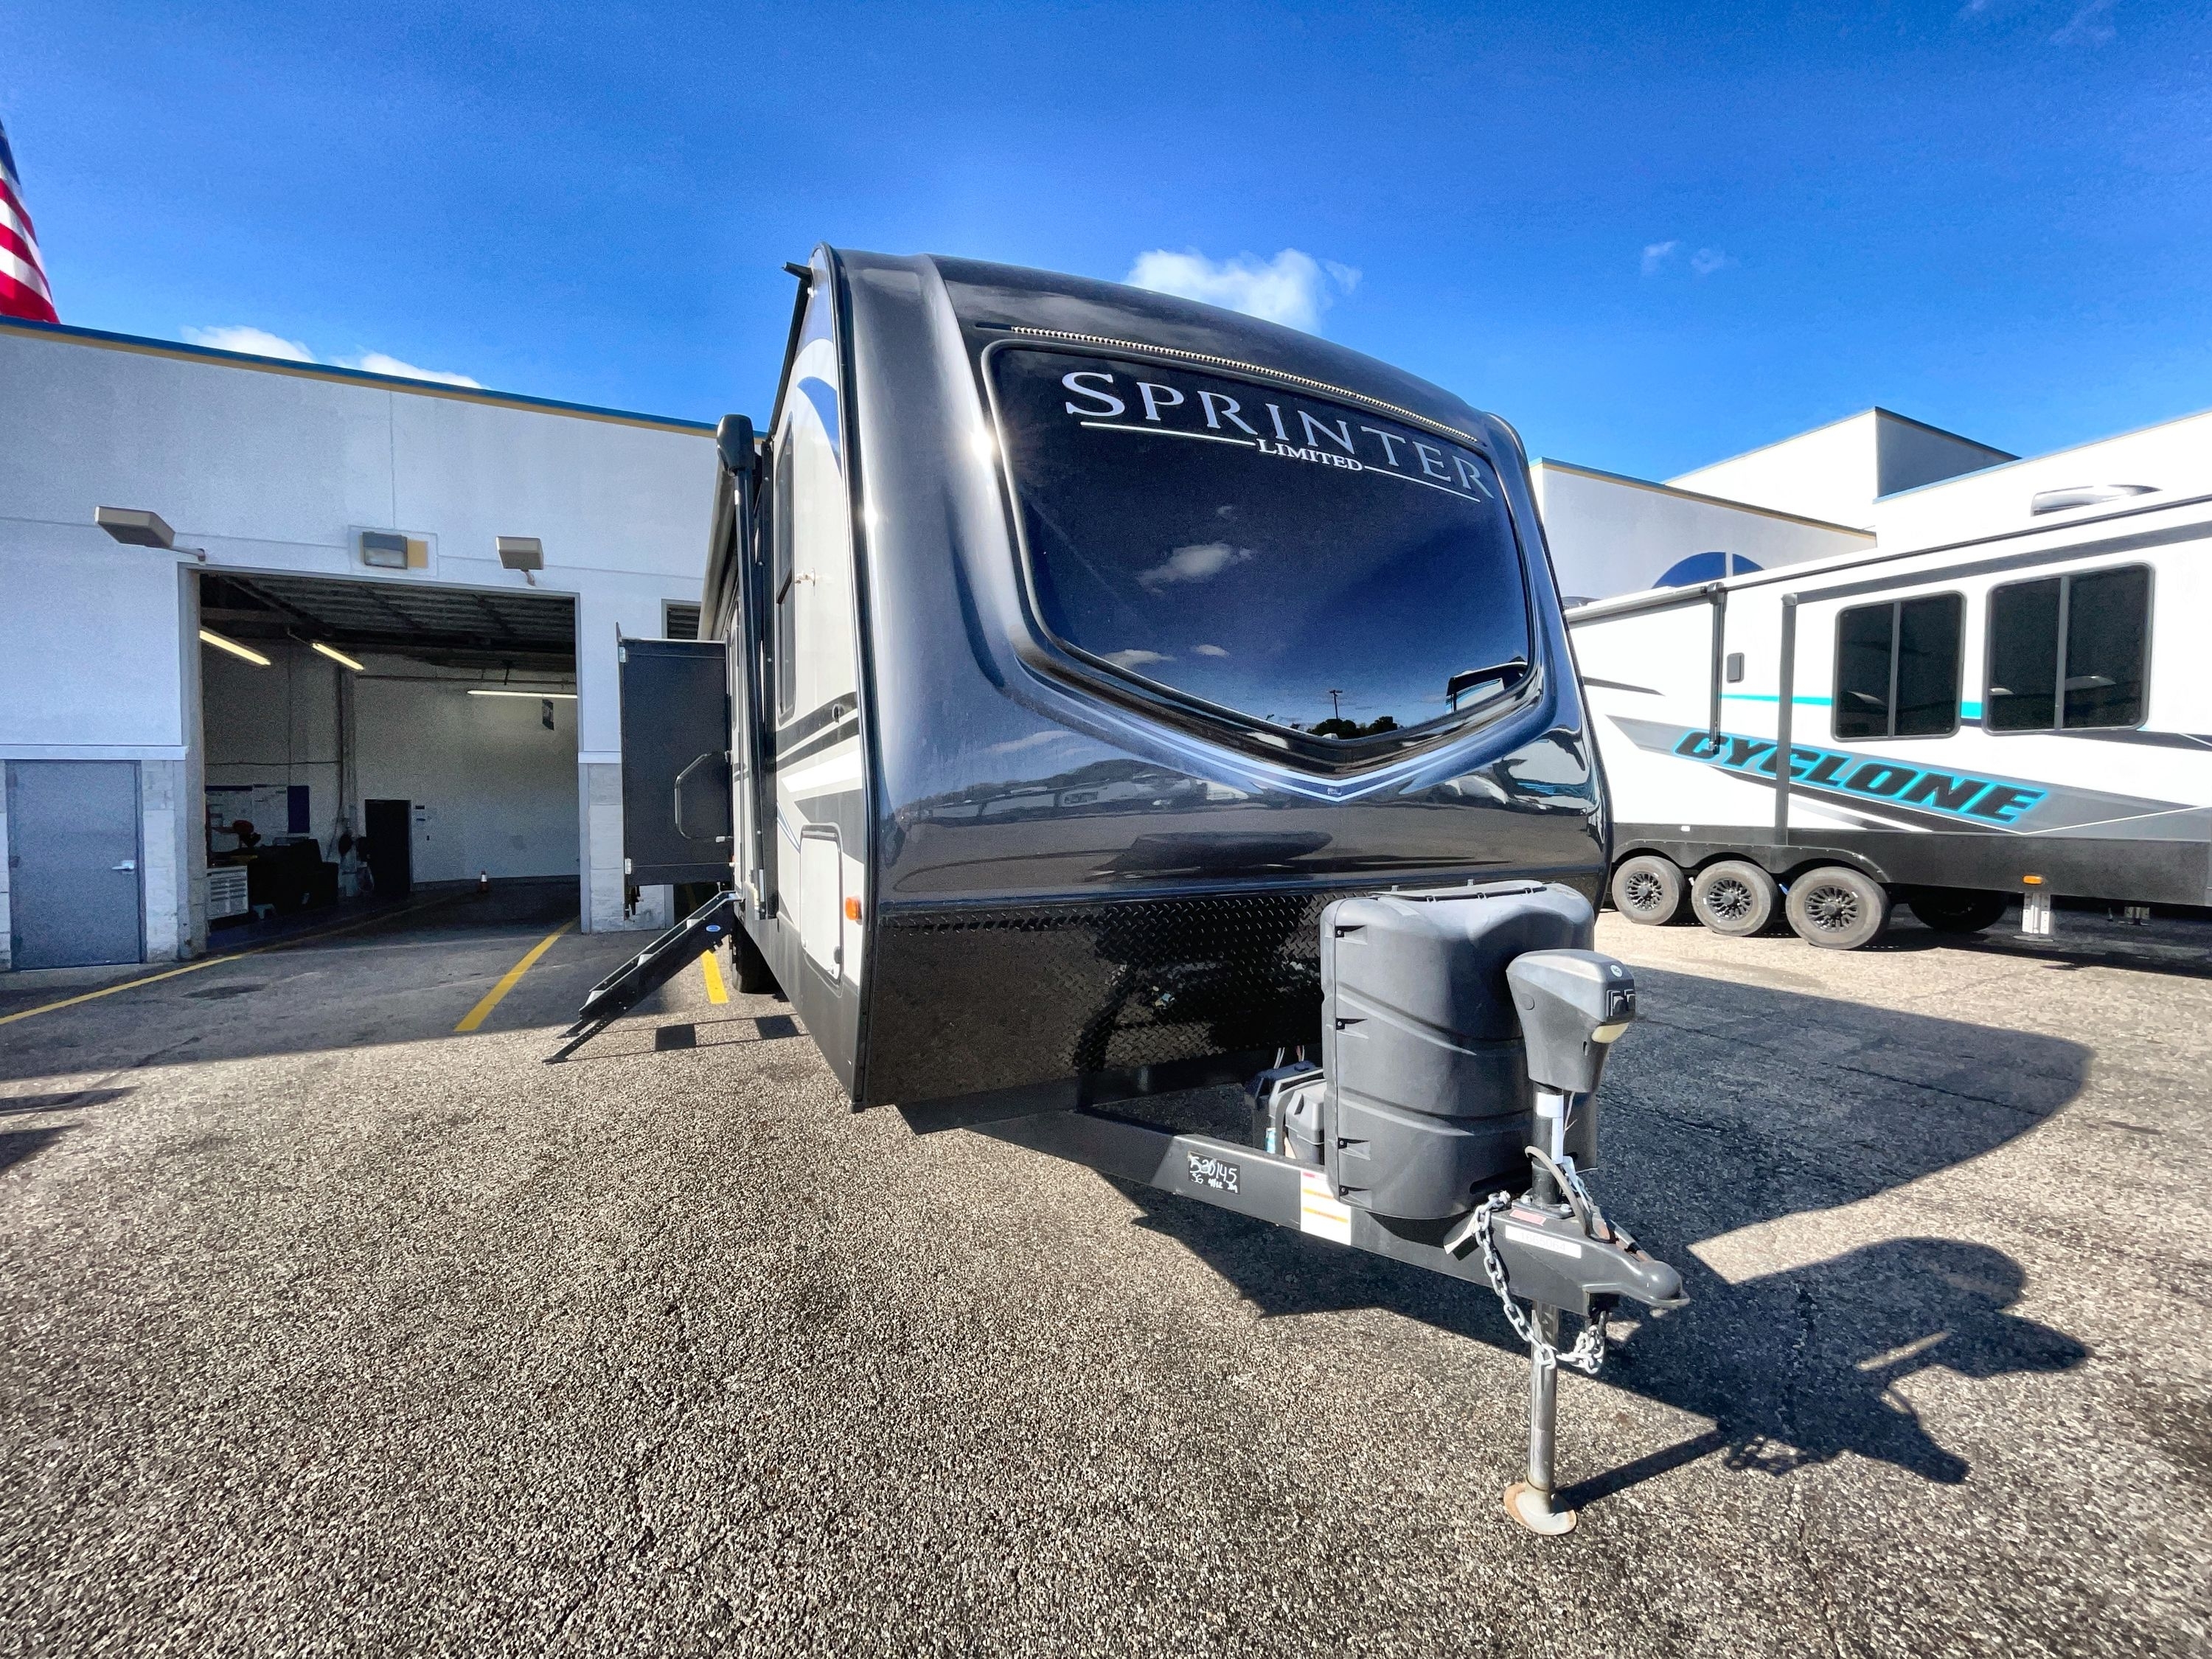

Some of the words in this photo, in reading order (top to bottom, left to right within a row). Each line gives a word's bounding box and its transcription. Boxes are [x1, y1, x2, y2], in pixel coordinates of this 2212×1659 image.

[1062, 371, 1495, 498] SPRINTER
[1256, 438, 1363, 472] LIMITED
[1672, 730, 2048, 823] CYCLONE
